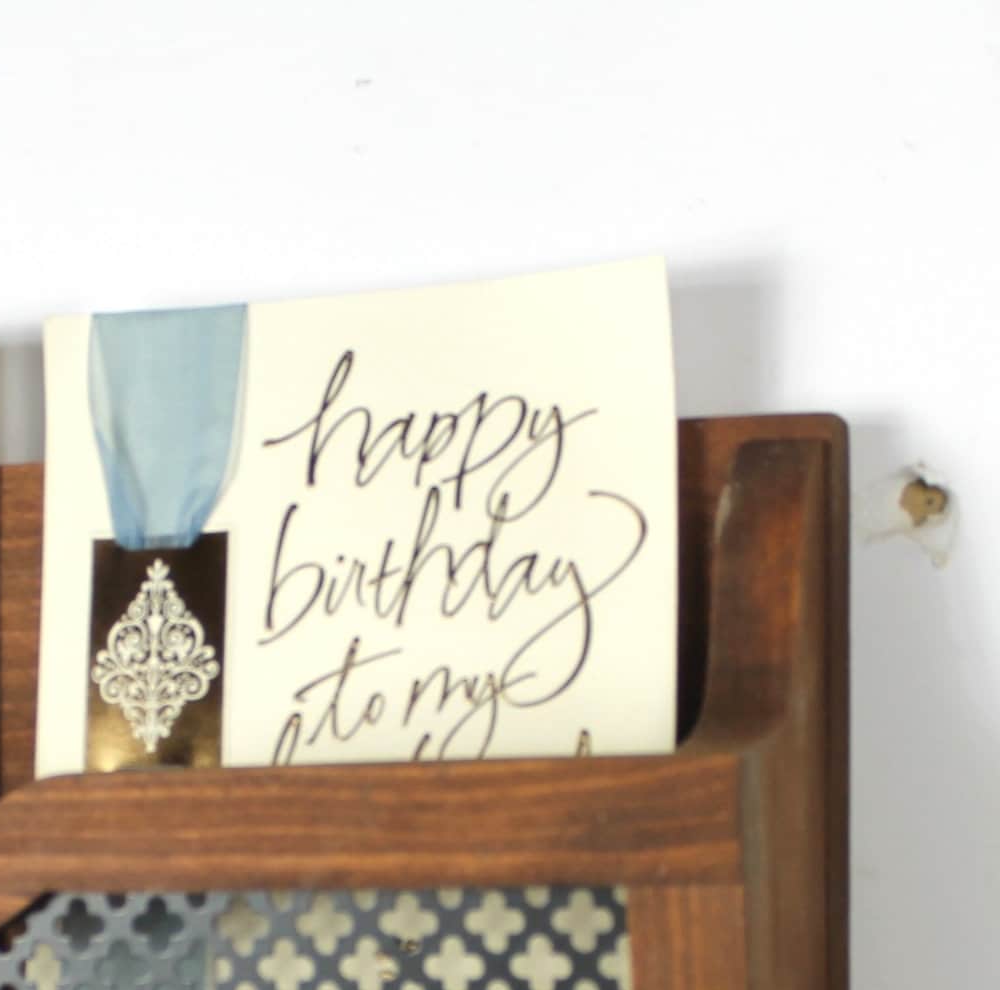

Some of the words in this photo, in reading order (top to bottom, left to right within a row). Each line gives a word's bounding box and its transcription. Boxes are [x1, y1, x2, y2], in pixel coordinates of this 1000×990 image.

[262, 350, 598, 522] happy
[257, 485, 648, 708] birthday
[293, 637, 402, 745] to
[403, 666, 536, 759] my
